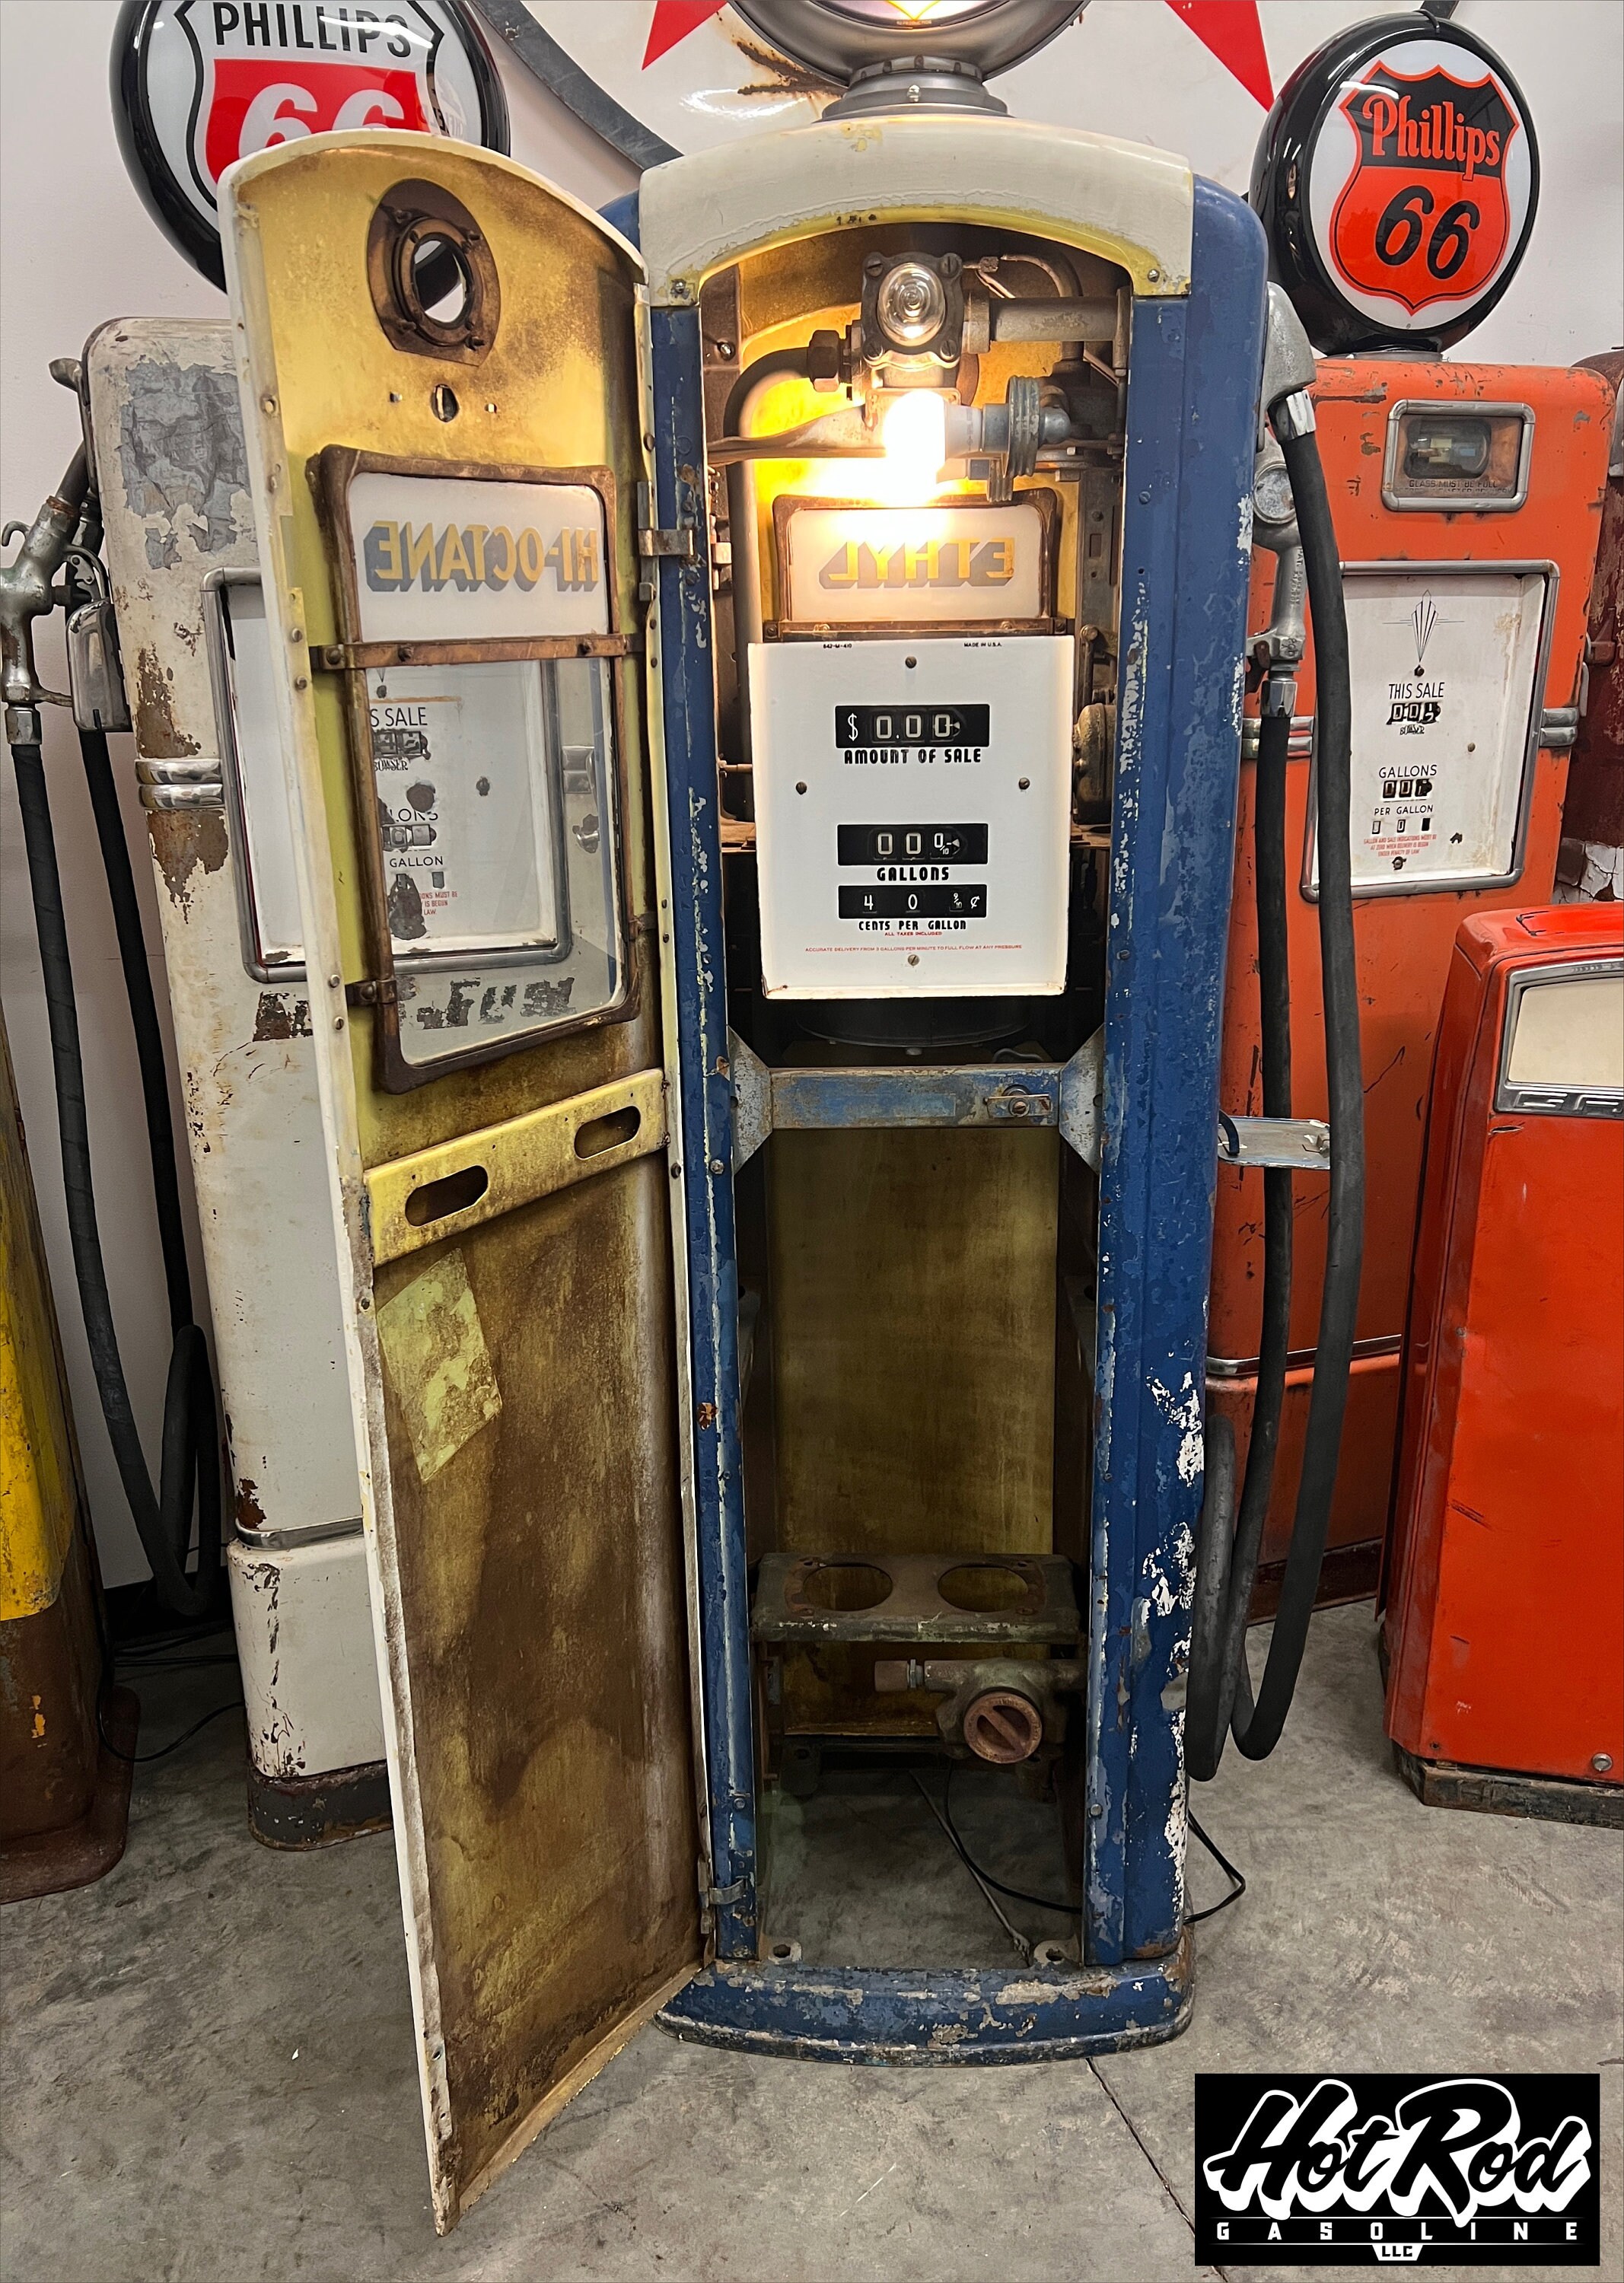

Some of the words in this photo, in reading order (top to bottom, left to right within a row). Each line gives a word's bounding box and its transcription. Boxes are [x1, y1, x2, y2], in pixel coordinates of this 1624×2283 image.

[212, 2, 412, 58] PHILLIPS
[1362, 94, 1501, 181] Phillips
[1374, 184, 1481, 280] 66
[1409, 479, 1436, 488] GLASS
[1438, 479, 1461, 488] MUST
[1389, 683, 1412, 699] THIS
[1415, 682, 1445, 699] SALE
[385, 707, 428, 727] SALE
[844, 749, 909, 764] AMOUNT
[918, 749, 936, 763] OF
[944, 748, 981, 763] SALE
[1378, 764, 1438, 779] GALLONS
[1374, 807, 1390, 816] PER
[1396, 804, 1434, 814] GALLON
[389, 855, 444, 868] GALLON
[877, 866, 949, 881] GALLONS
[864, 894, 874, 911] 4
[858, 921, 890, 931] CENTS
[899, 920, 919, 930] PER
[928, 920, 966, 930] GALLON
